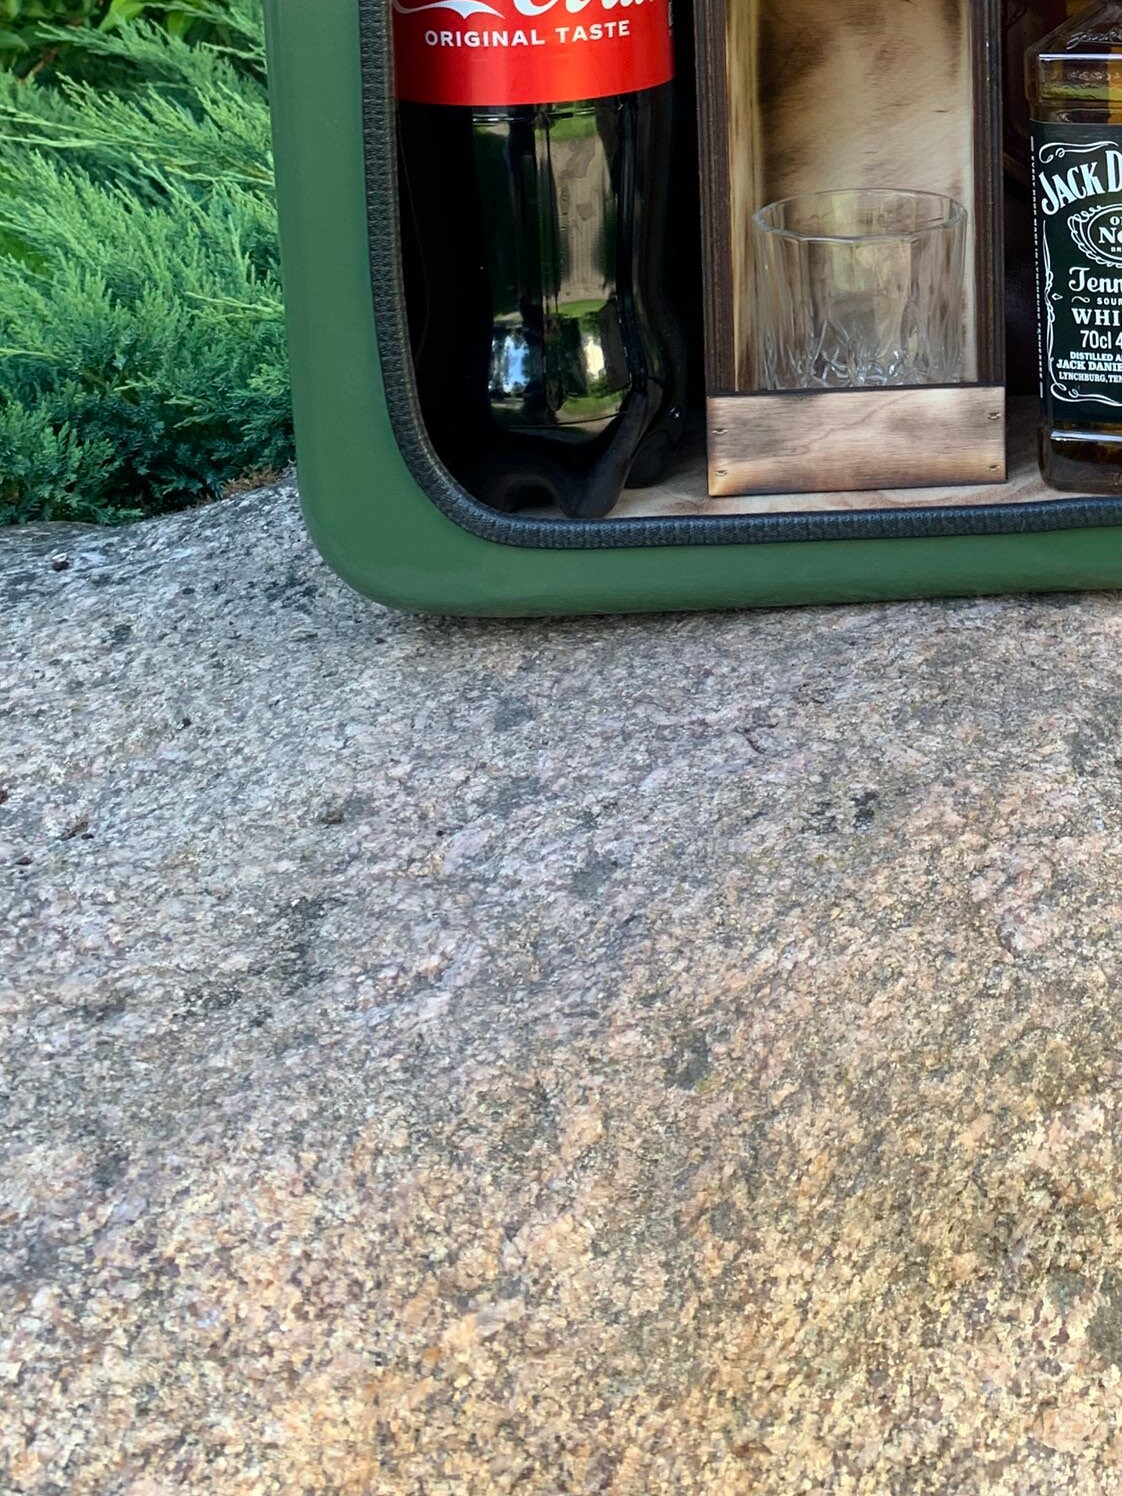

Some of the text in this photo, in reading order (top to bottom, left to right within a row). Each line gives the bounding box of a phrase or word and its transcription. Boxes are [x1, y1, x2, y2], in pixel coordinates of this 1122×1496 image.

[425, 20, 631, 47] ORIGINAL TASTE
[1038, 161, 1106, 215] JACK
[1080, 330, 1112, 349] 70cl
[1056, 359, 1086, 370] JACK
[1070, 351, 1113, 361] DISTILLED
